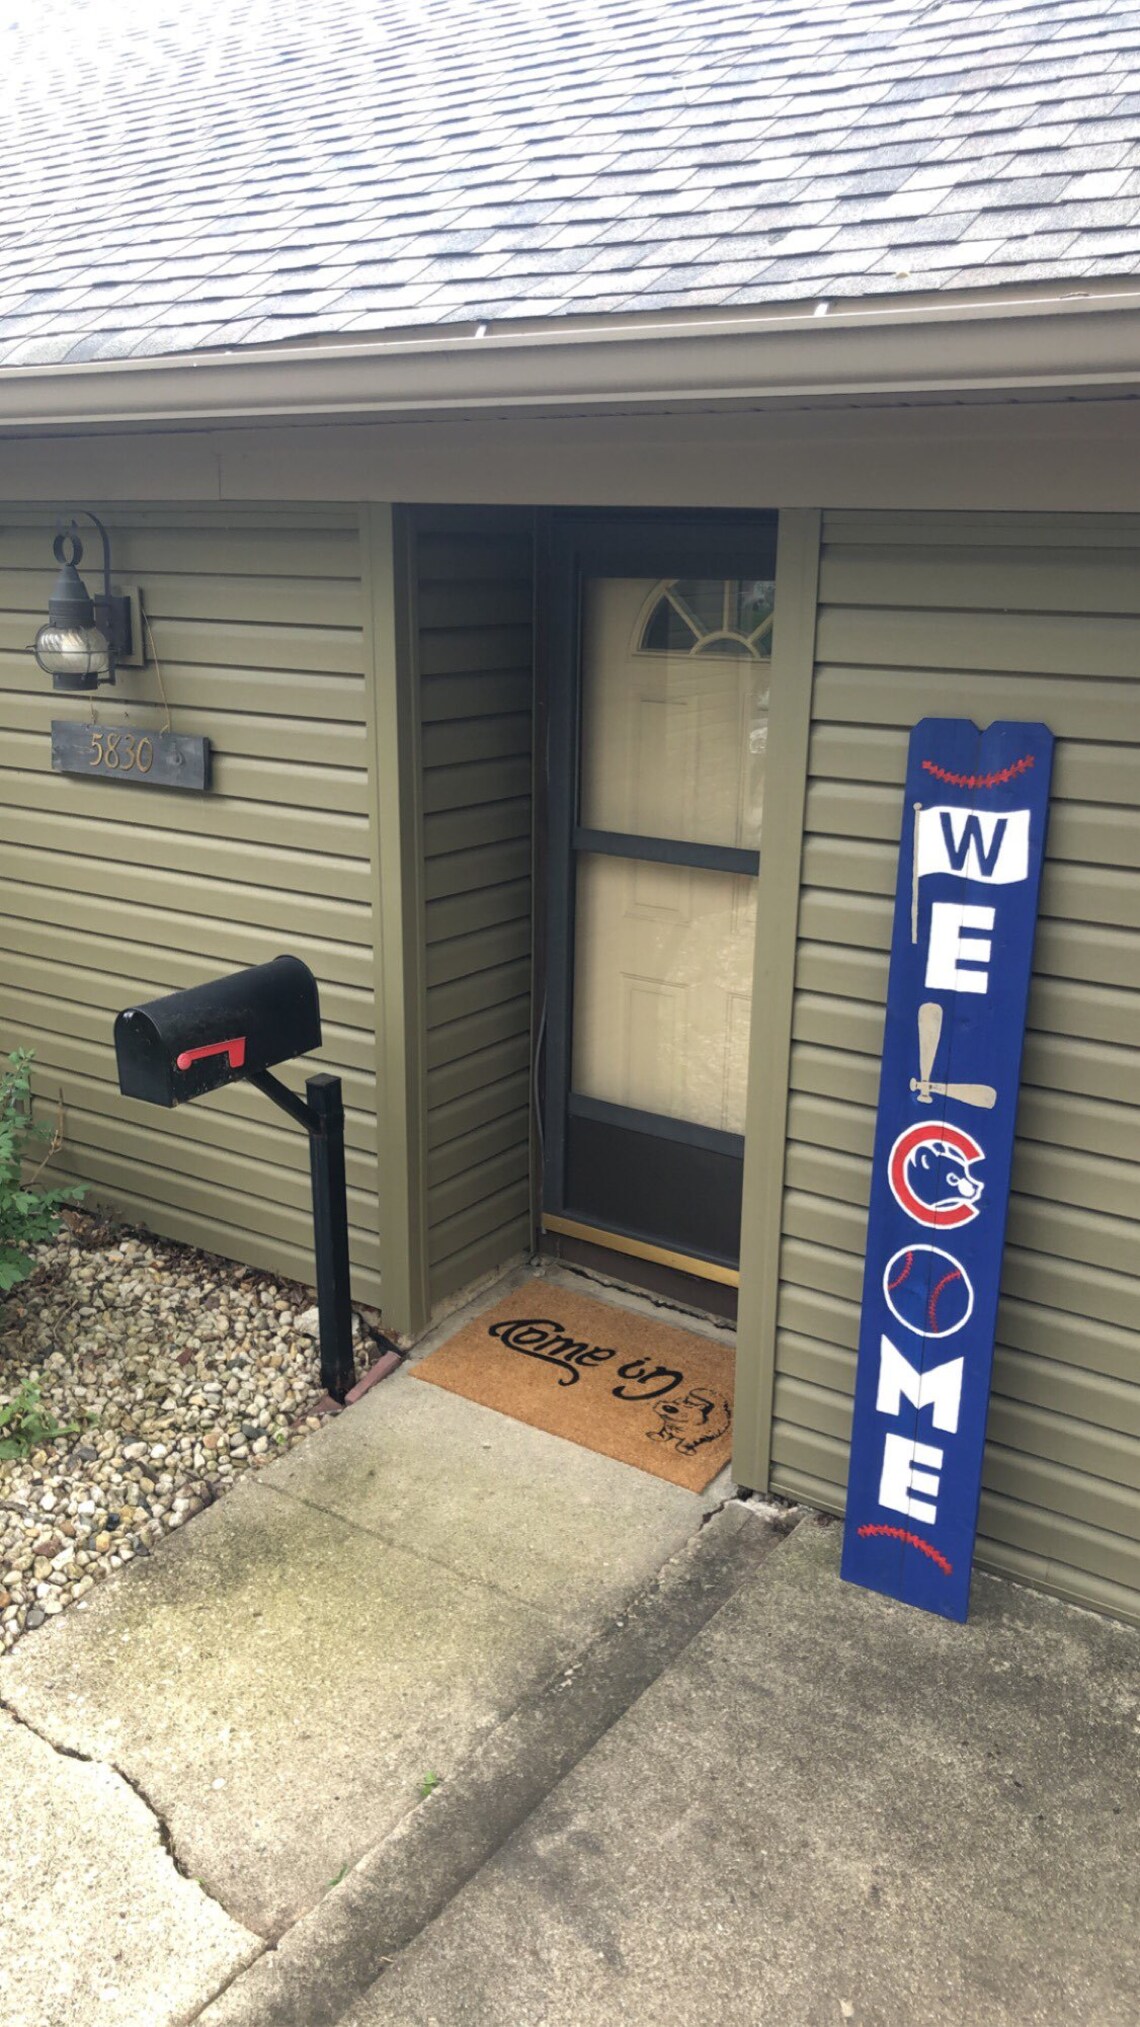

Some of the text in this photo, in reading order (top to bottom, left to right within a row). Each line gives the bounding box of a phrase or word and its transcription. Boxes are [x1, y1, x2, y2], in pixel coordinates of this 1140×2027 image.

[89, 732, 154, 773] 5830
[488, 1318, 684, 1401] Come in
